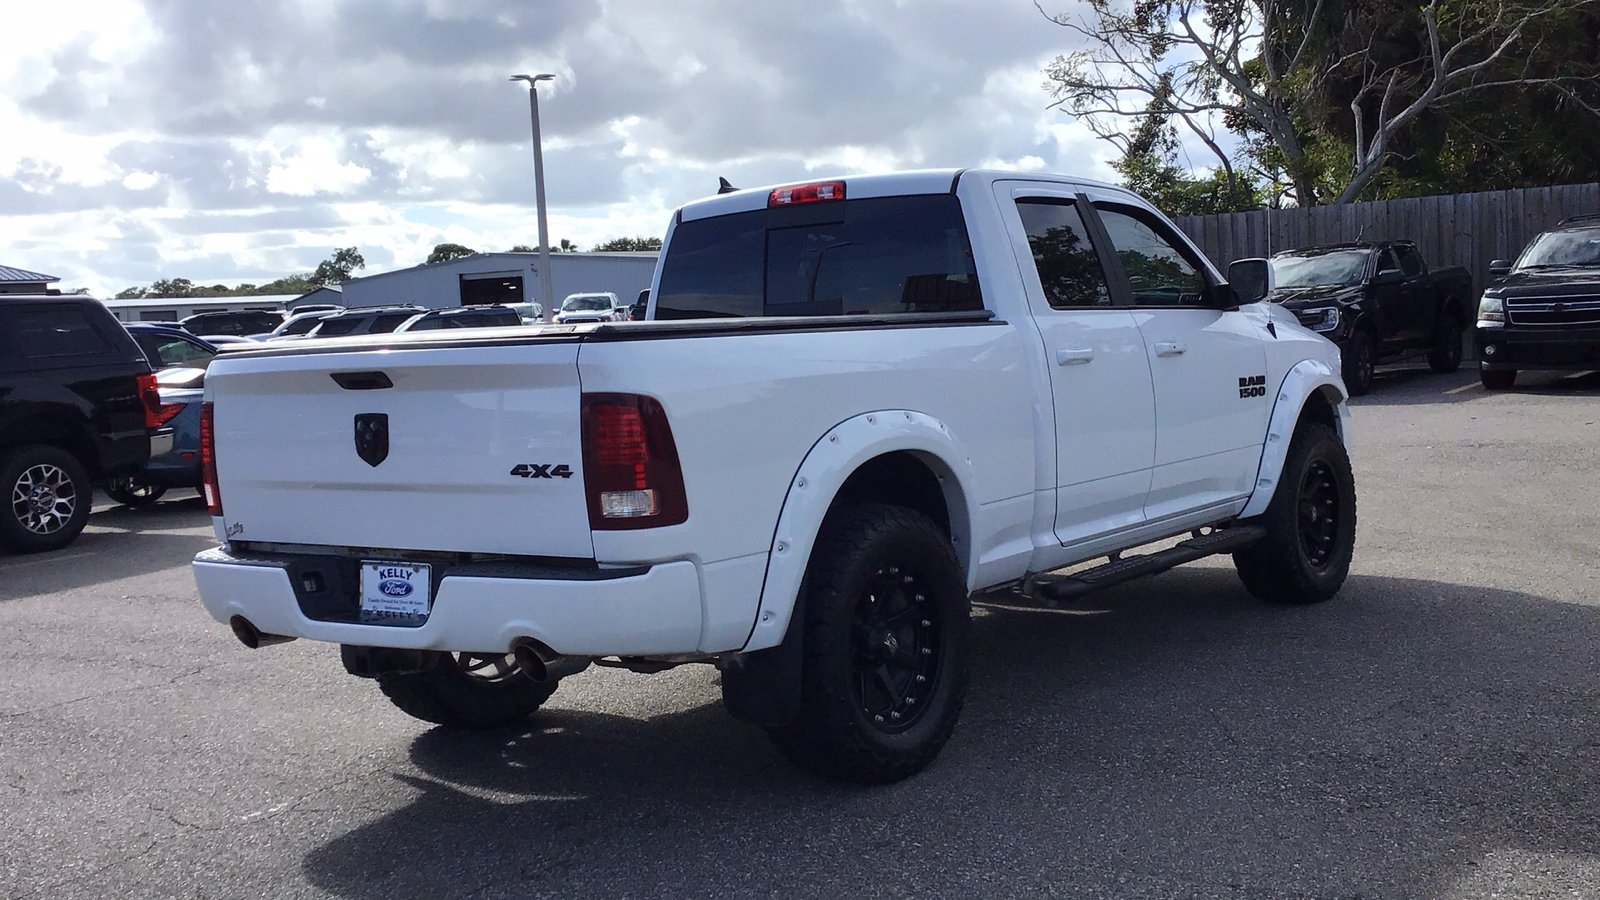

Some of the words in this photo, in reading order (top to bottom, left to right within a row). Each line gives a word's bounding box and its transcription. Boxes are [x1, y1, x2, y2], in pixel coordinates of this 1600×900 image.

[1239, 375, 1265, 387] RAM
[1239, 386, 1266, 398] 1500
[379, 568, 413, 580] KELLY
[384, 580, 407, 595] Ford
